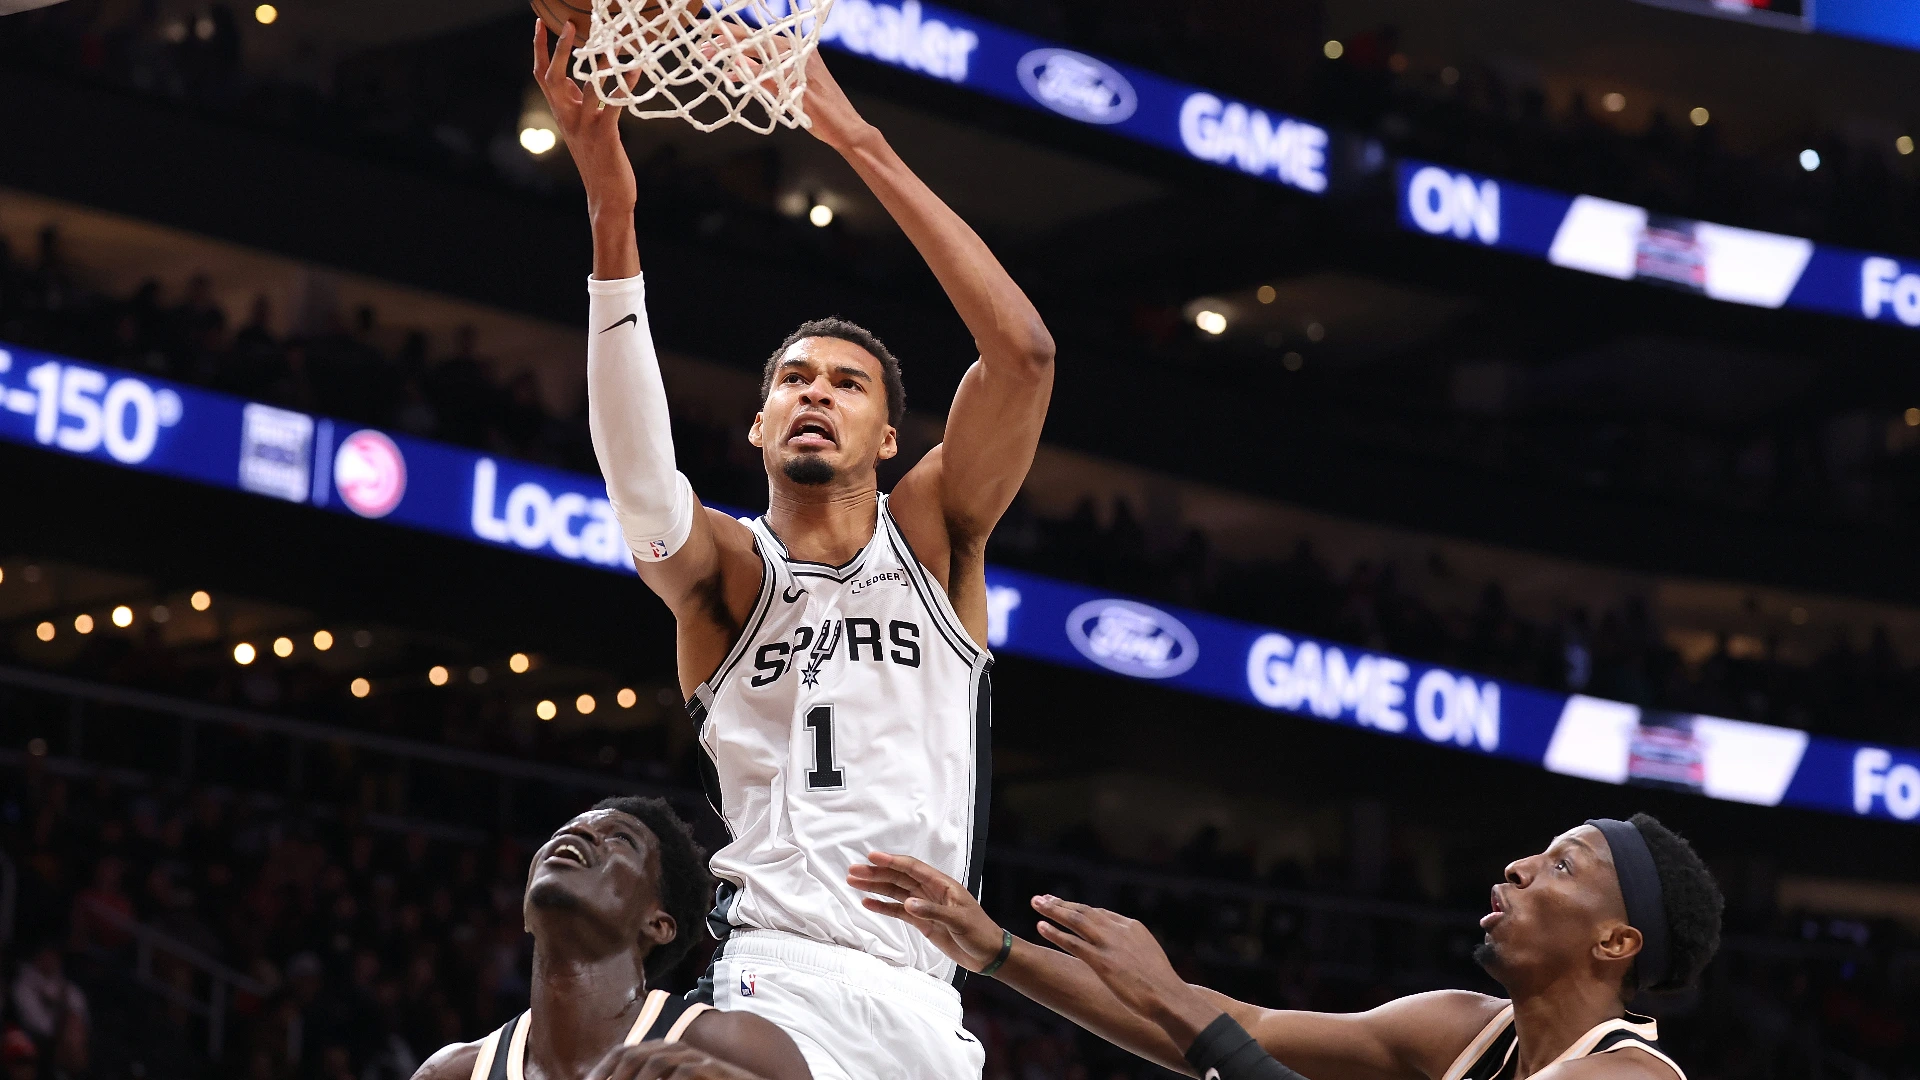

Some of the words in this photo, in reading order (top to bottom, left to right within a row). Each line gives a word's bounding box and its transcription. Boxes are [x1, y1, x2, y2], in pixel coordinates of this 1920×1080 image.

[1179, 91, 1329, 193] GAME
[1408, 165, 1501, 245] ON
[0, 349, 183, 465] -150
[858, 572, 901, 589] LEDGER
[751, 617, 921, 688] SPURS
[1247, 632, 1410, 733] GAME
[1414, 668, 1500, 752] ON
[802, 703, 847, 792] 1
